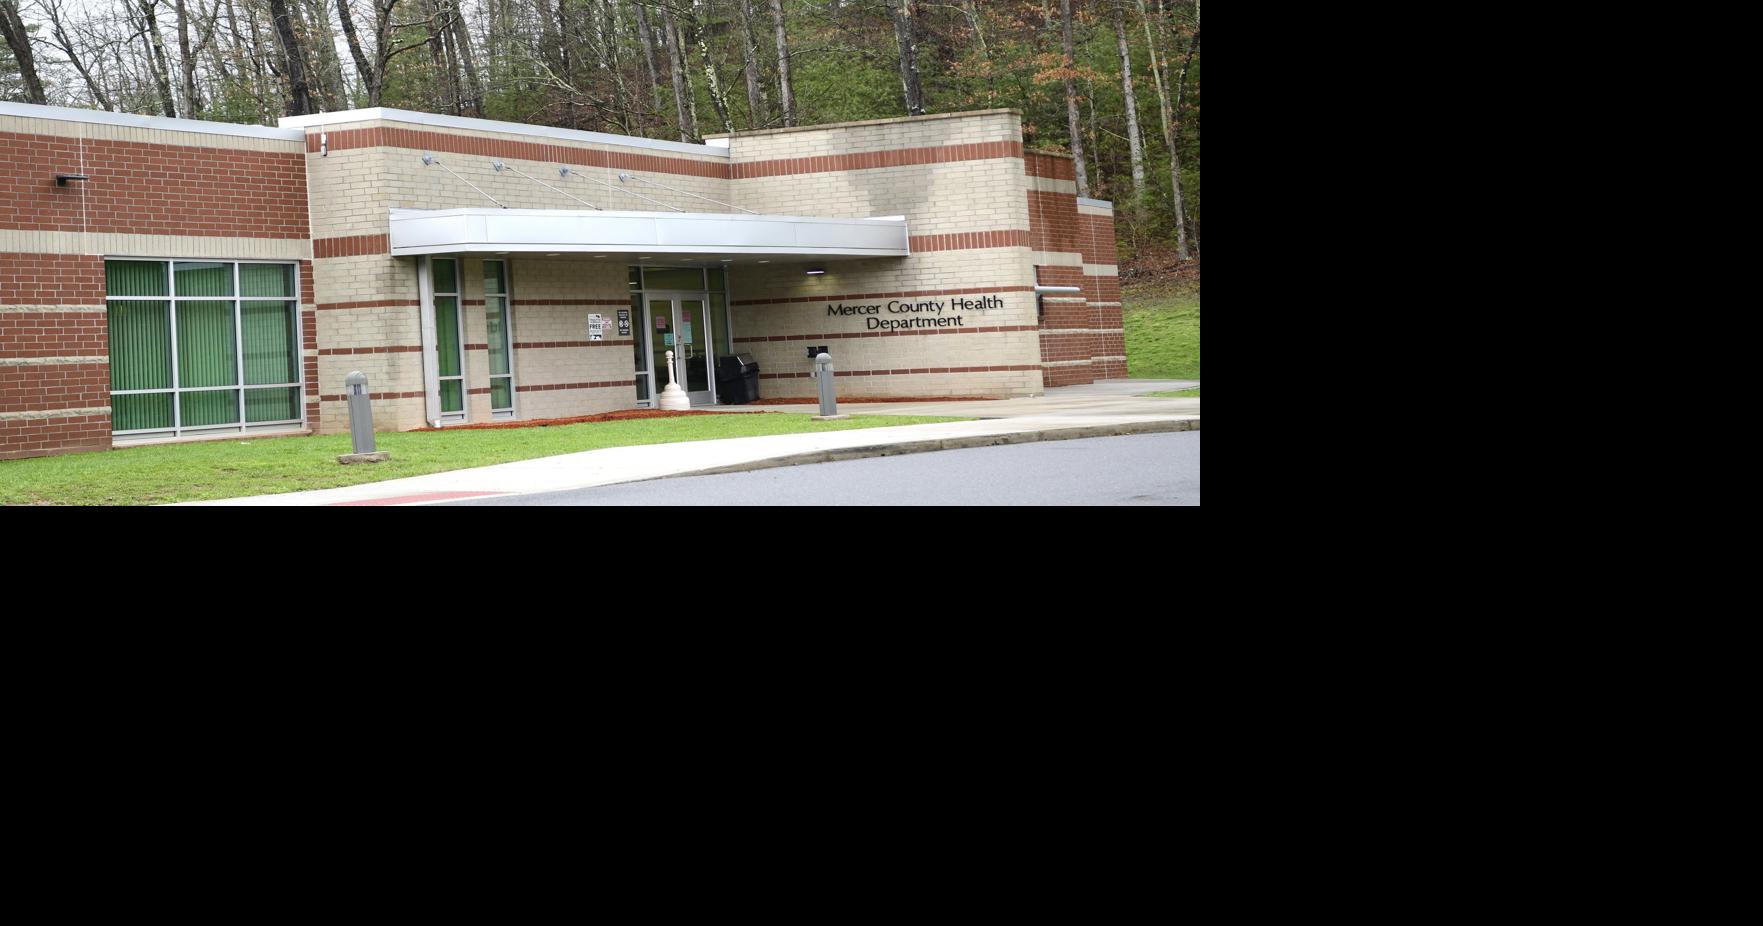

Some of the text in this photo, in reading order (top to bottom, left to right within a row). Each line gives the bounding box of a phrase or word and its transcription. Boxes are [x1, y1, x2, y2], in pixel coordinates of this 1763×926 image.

[827, 295, 1003, 316] Mercer County Health
[866, 315, 963, 332] Department
